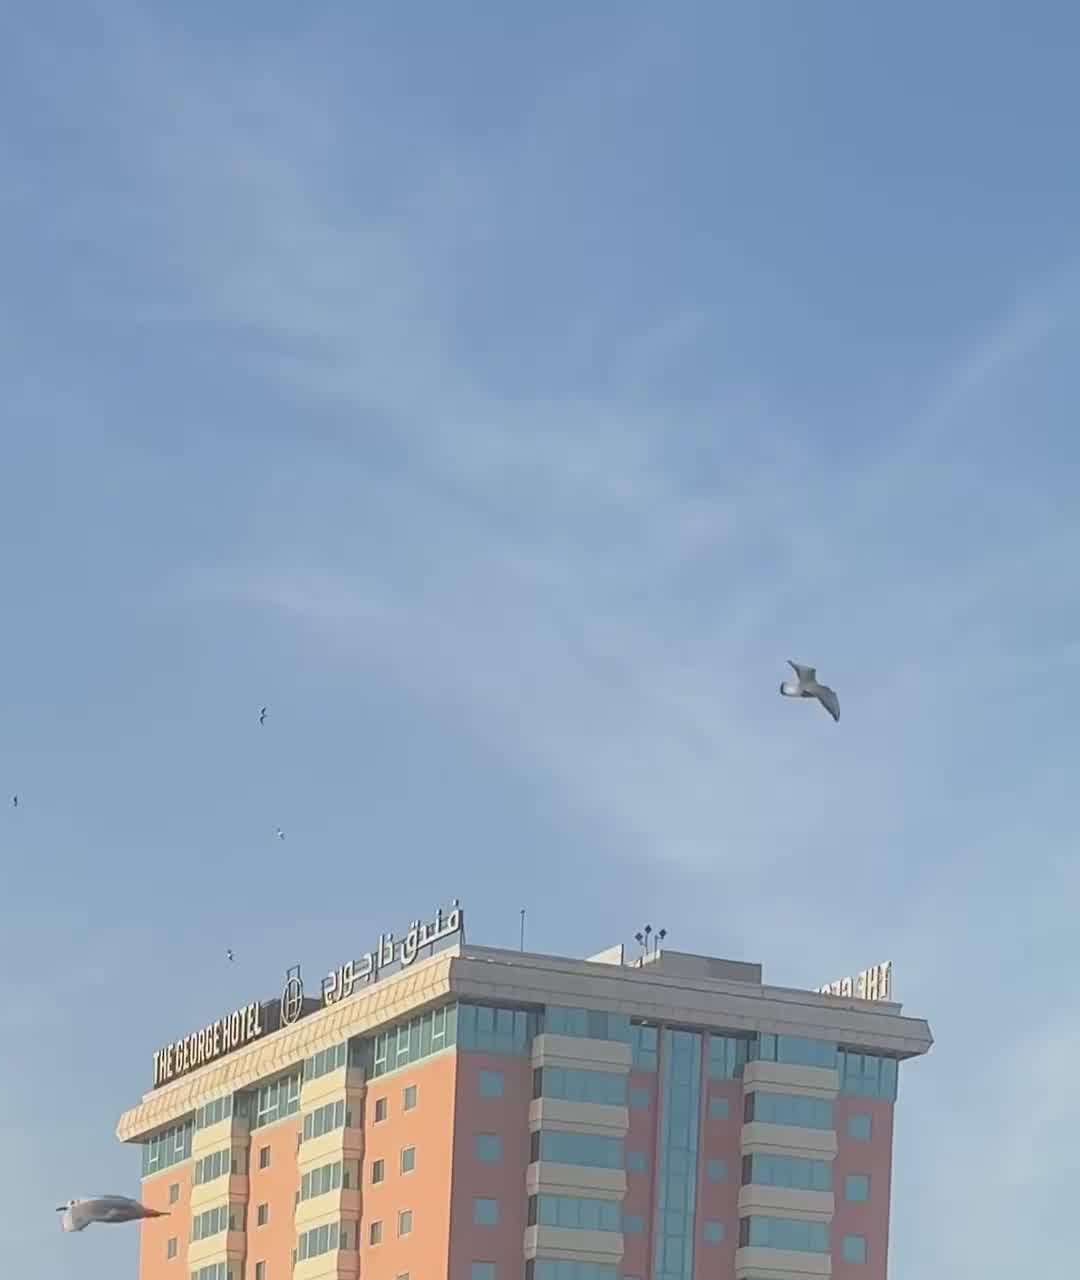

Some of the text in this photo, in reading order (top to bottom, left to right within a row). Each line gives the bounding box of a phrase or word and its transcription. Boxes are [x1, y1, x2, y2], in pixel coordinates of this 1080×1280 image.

[401, 898, 461, 965] فندق
[152, 1000, 262, 1085] THE GEORGE HOTEL
